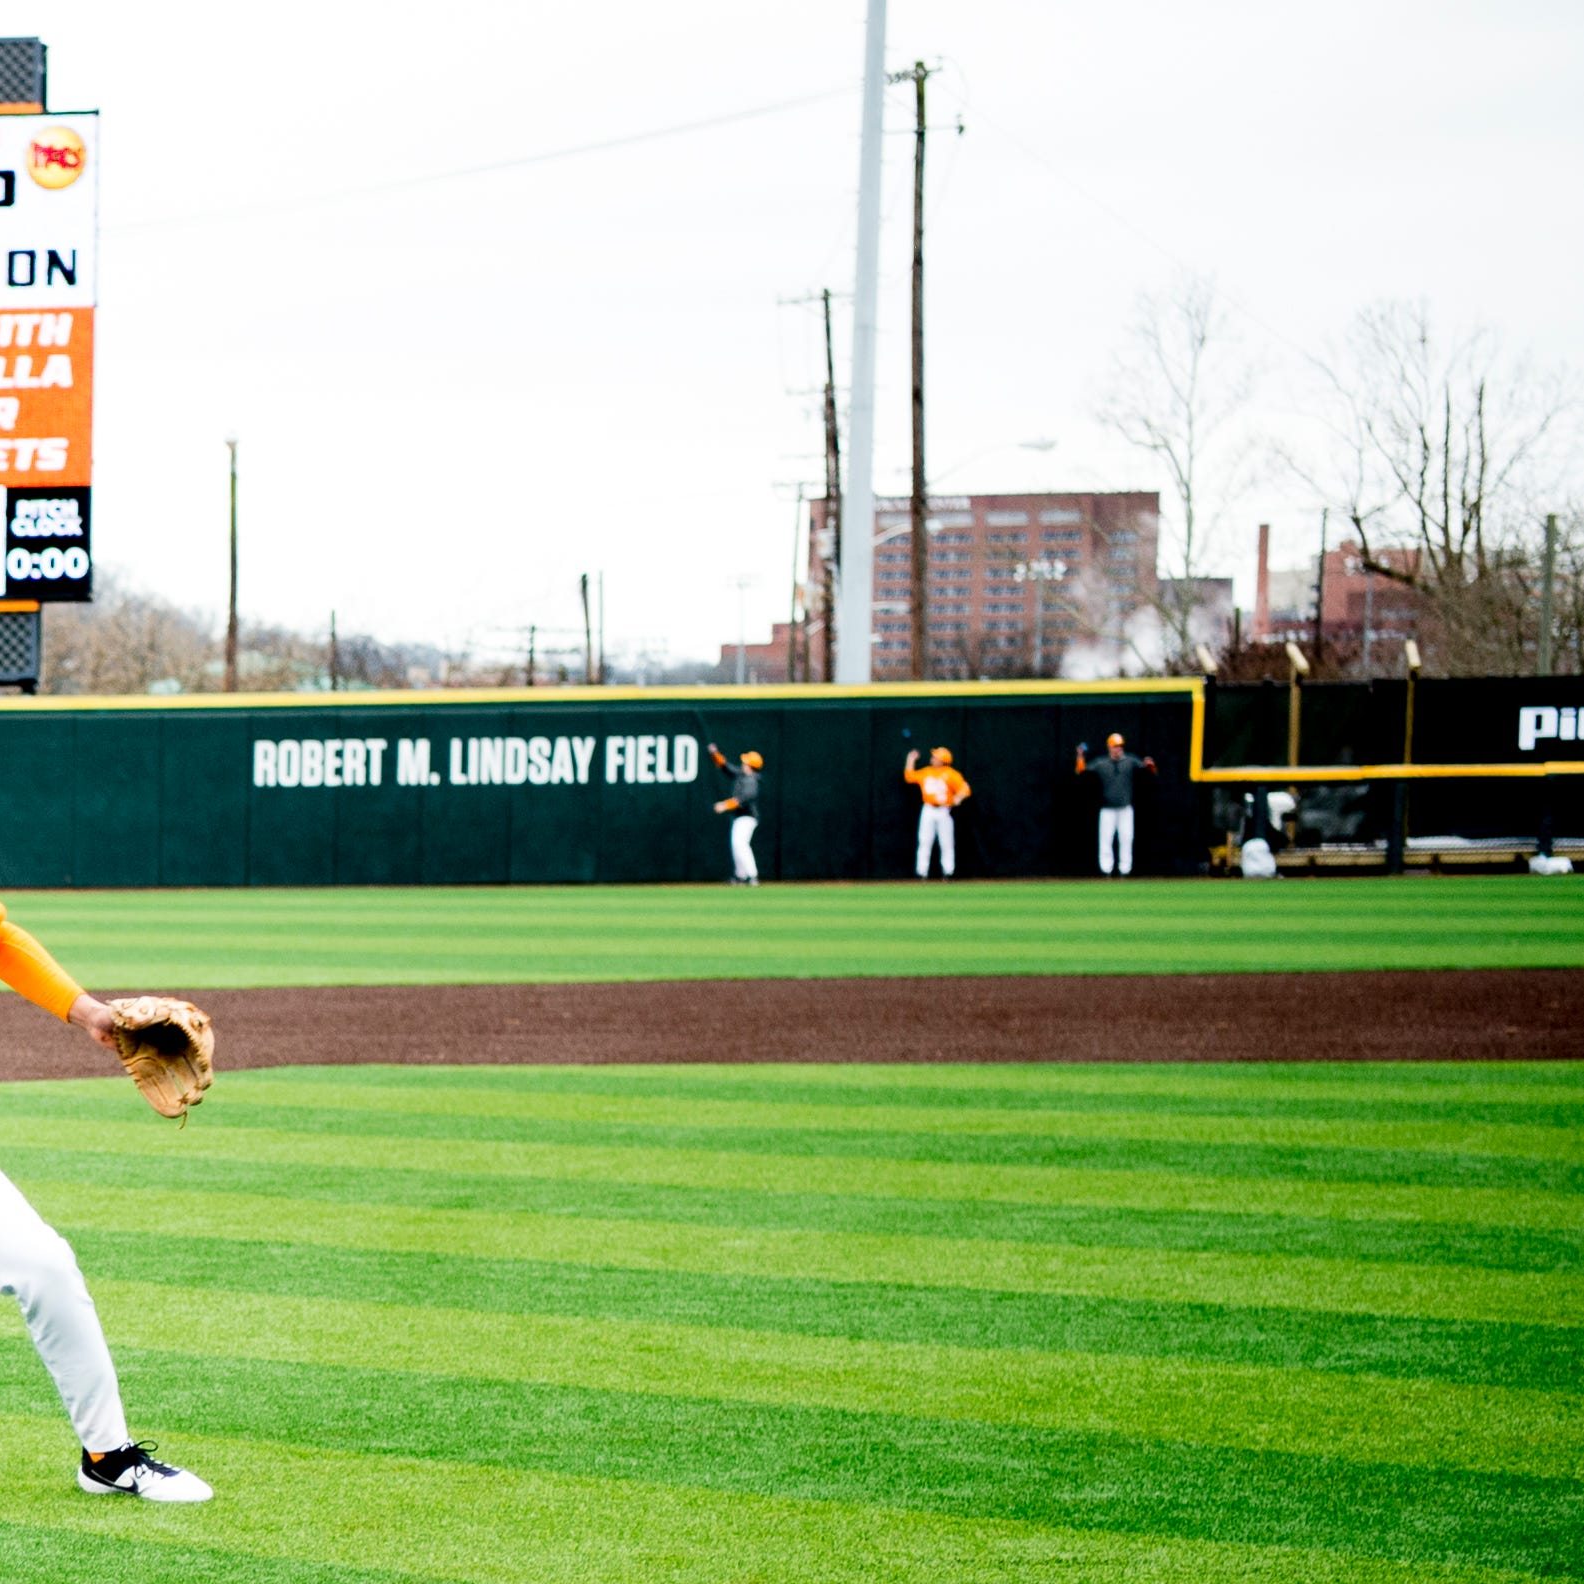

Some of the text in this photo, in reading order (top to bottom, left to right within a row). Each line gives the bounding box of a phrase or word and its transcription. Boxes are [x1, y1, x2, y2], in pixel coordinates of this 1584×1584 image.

[6, 546, 89, 580] 0:00
[253, 734, 699, 787] ROBERT M. LINDSAY FIELD
